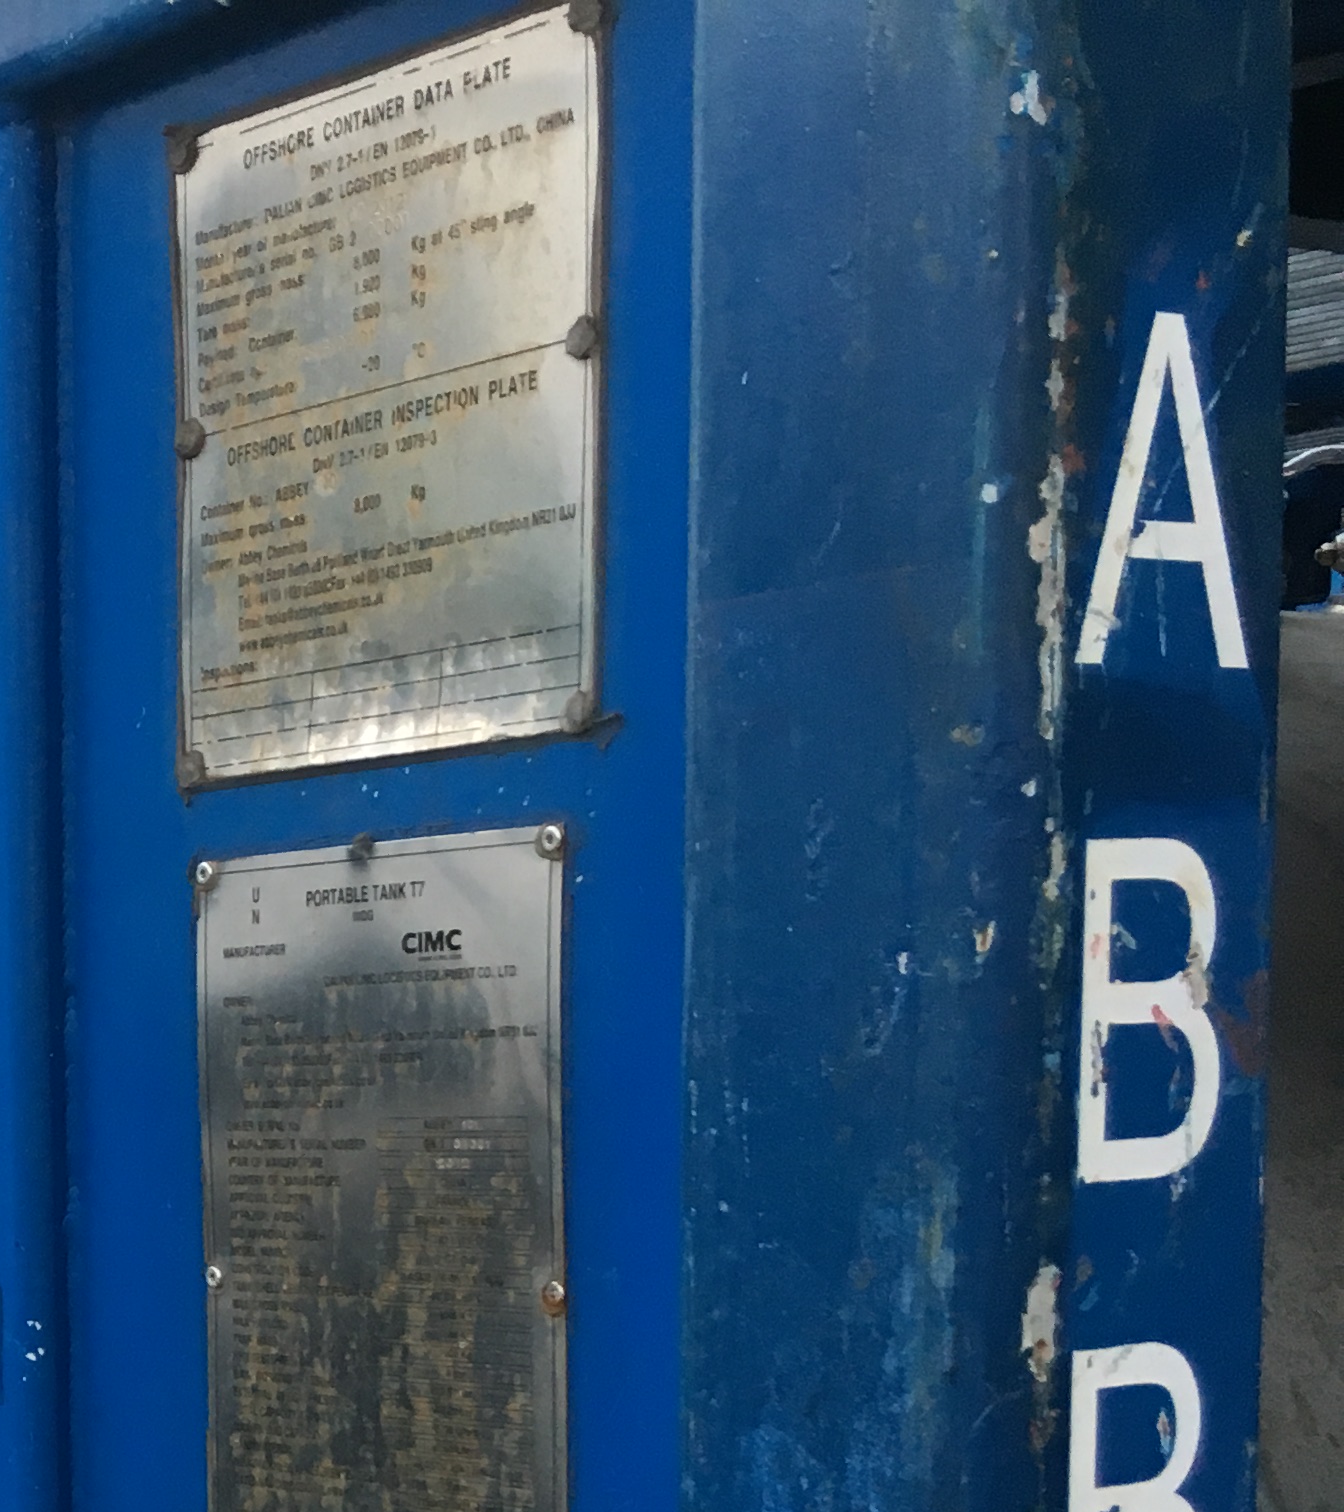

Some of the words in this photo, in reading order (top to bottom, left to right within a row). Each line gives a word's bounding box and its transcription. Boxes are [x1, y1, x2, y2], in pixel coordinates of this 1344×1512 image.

[243, 126, 314, 170] OFFSHORE
[323, 95, 405, 142] CONTAINER
[413, 78, 454, 111] DATA
[463, 56, 511, 96] PLATE
[402, 142, 468, 179] EQUIPMENT
[227, 431, 296, 467] OFFSHORE
[303, 409, 383, 448] CONTAINER
[391, 385, 480, 427] INSPECTION
[488, 369, 538, 401] PLATE
[305, 885, 370, 908] PORTABLE
[372, 881, 407, 902] TANK
[409, 880, 426, 898] T7
[400, 928, 463, 954] CIMC
